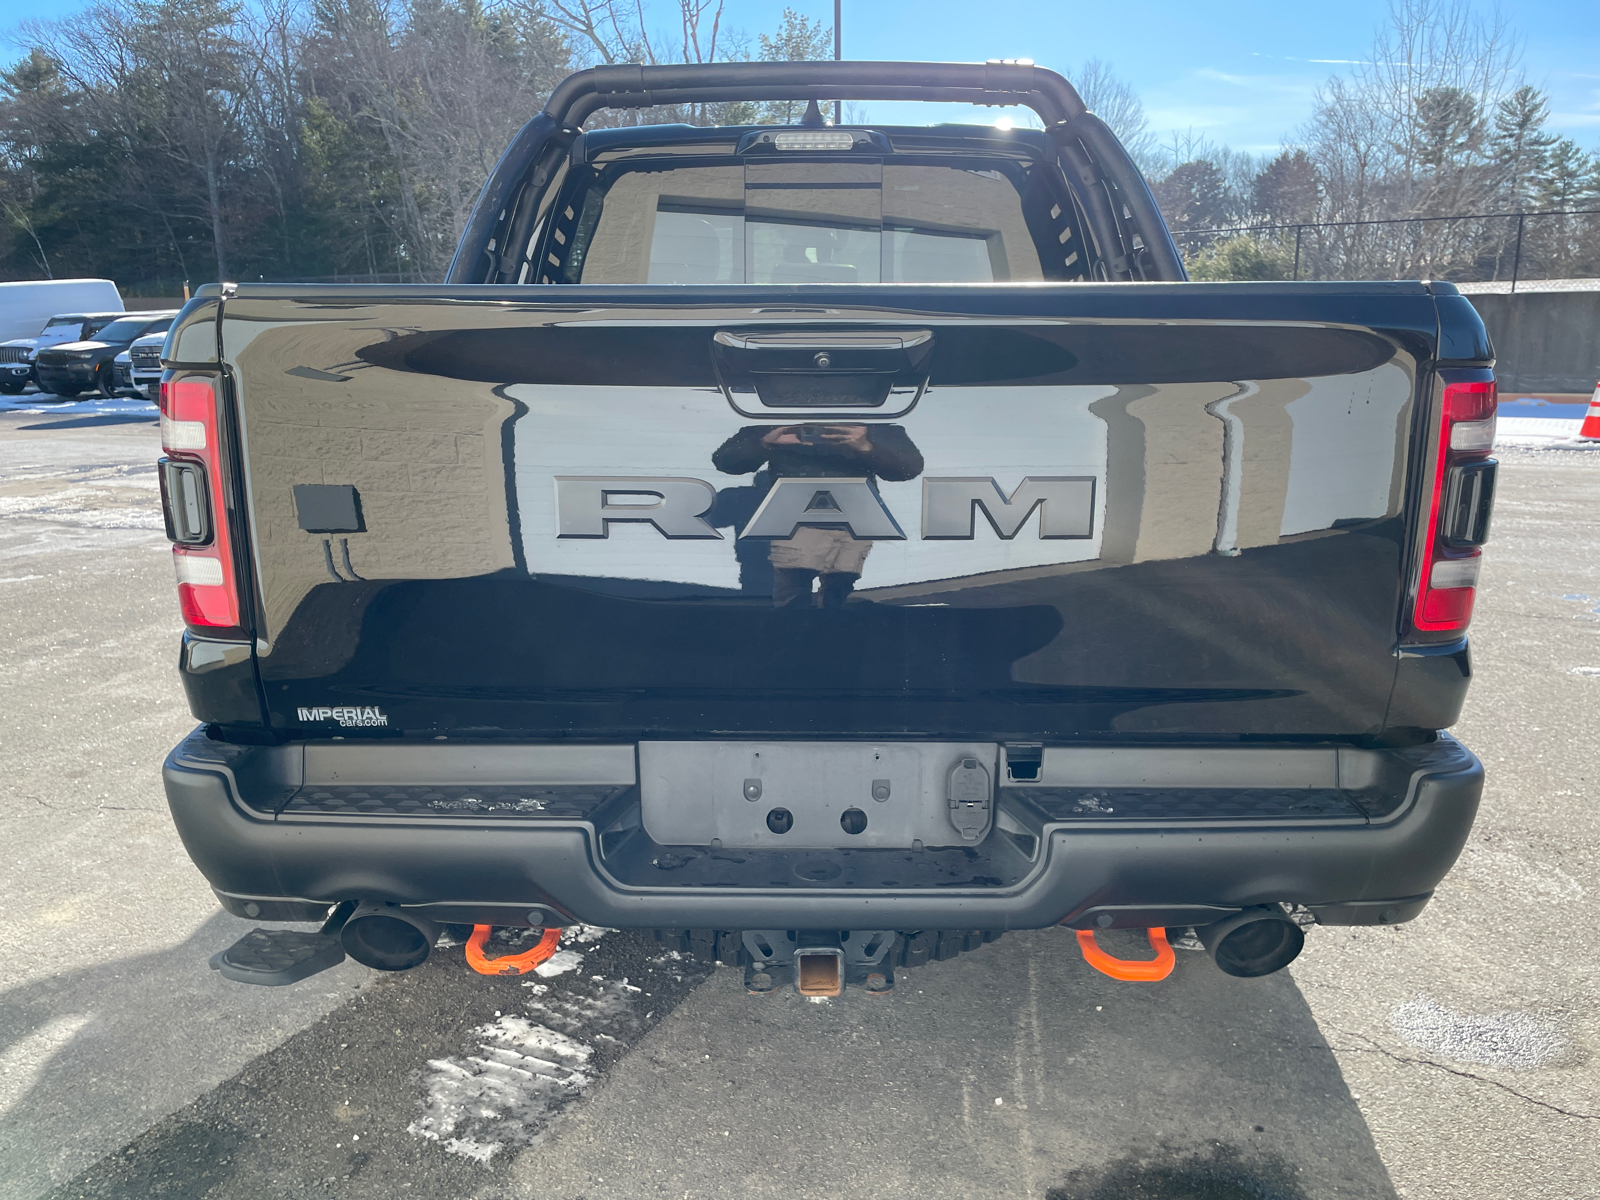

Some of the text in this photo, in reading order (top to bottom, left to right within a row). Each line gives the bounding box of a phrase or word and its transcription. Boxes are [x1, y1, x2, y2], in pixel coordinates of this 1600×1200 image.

[553, 475, 1098, 541] RAM
[297, 706, 387, 721] IMPERIAL
[340, 719, 388, 727] cars.com
